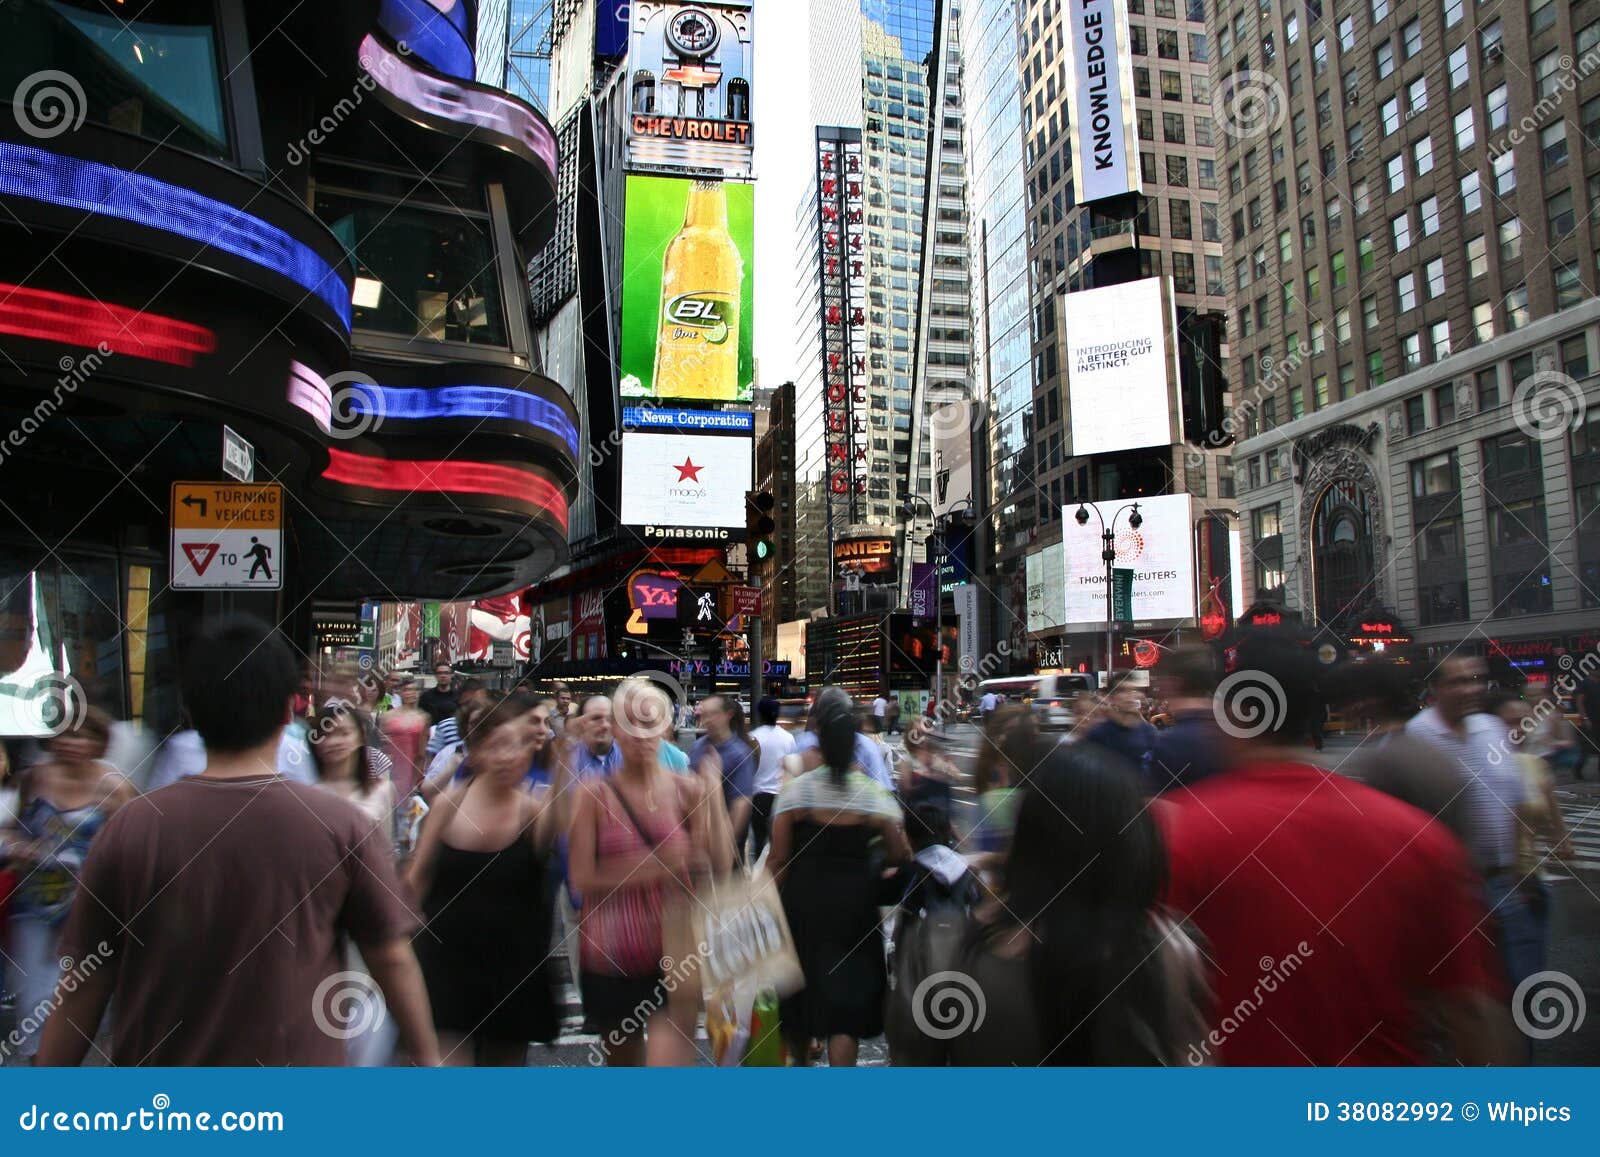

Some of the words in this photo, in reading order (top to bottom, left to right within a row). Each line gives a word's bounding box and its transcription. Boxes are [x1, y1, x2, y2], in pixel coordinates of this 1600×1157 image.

[1083, 11, 1113, 170] KNOWLEDGE
[633, 116, 749, 141] CHEVROLET
[674, 300, 722, 320] BL
[1076, 338, 1152, 357] INTRODUCING
[1087, 350, 1128, 363] BETTER
[1130, 346, 1153, 356] GUT
[1077, 358, 1130, 373] INSTINCT.
[642, 411, 673, 424] News
[678, 412, 749, 427] Corporation
[827, 351, 848, 494] YOUNG
[214, 491, 277, 504] TURNING
[215, 509, 275, 522] VEHICLES
[645, 526, 729, 539] Panasonic
[219, 553, 238, 566] TO
[1132, 571, 1177, 581] REUTERS
[694, 661, 723, 673] YOK
[724, 661, 751, 673] POLI
